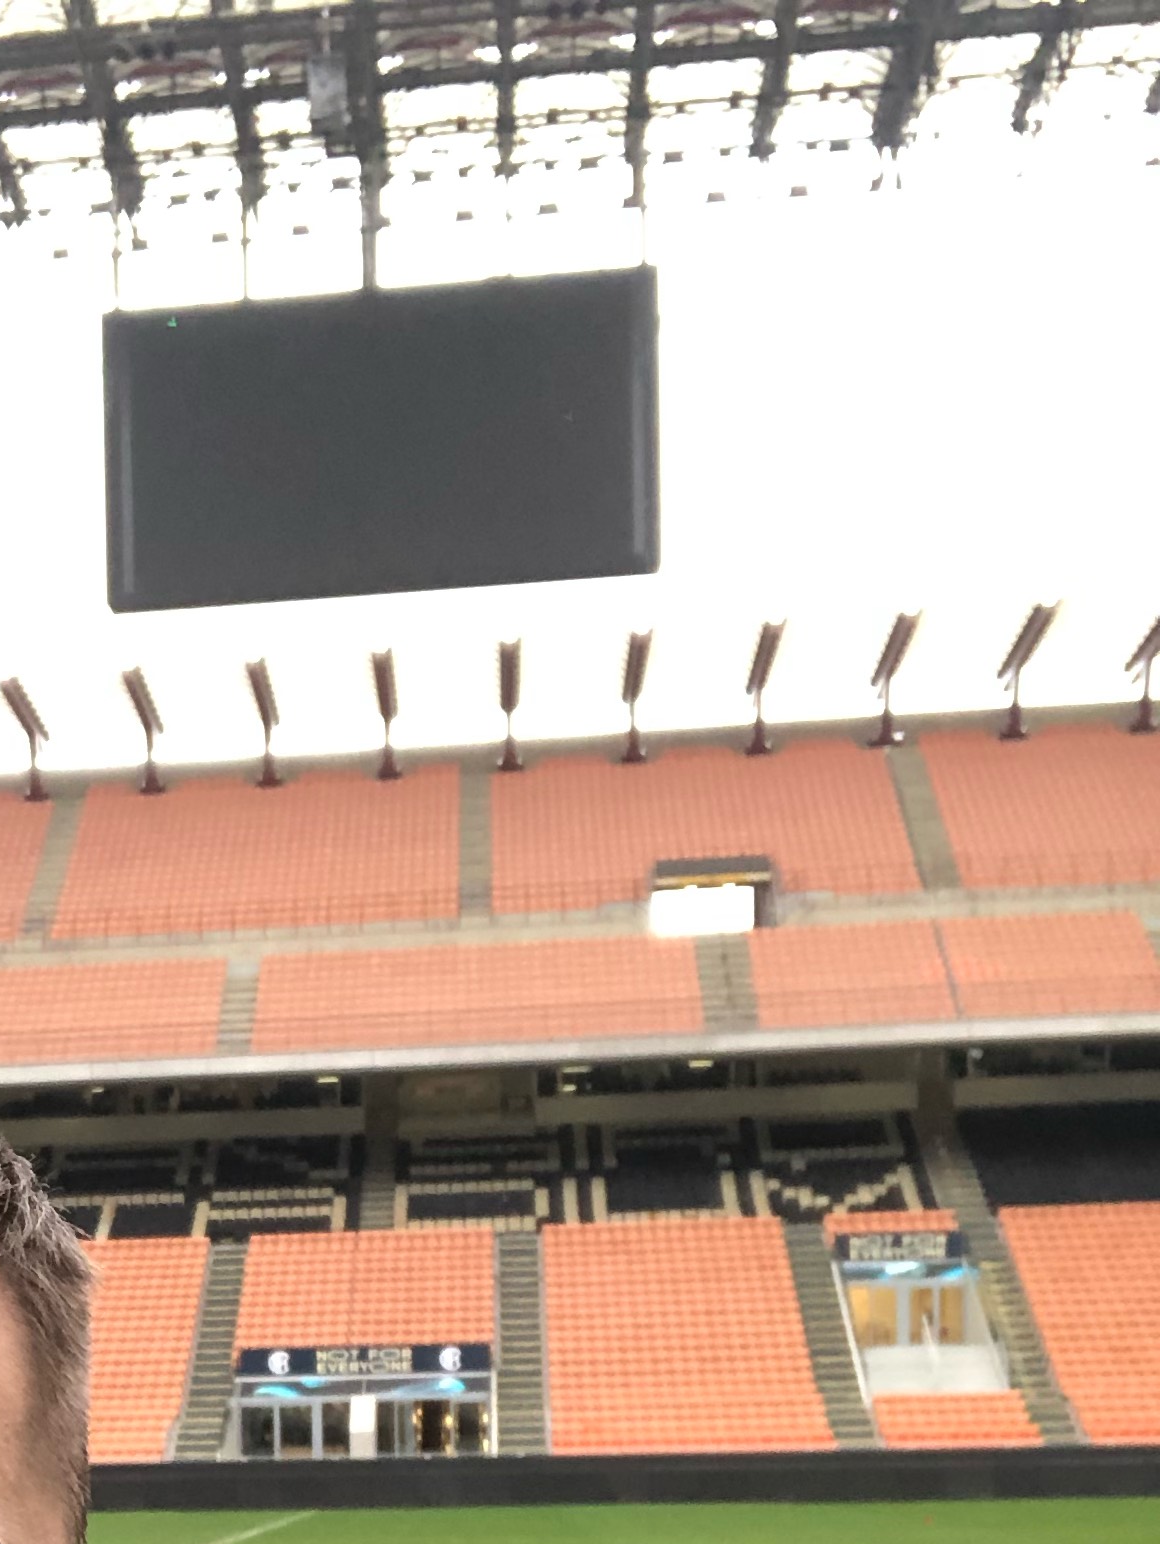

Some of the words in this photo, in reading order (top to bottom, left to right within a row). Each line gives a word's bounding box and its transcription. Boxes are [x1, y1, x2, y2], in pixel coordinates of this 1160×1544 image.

[47, 1163, 925, 1241] TADIUM
[315, 1348, 360, 1361] NOT
[368, 1346, 413, 1360] FOR
[315, 1360, 413, 1374] EVERYONE
